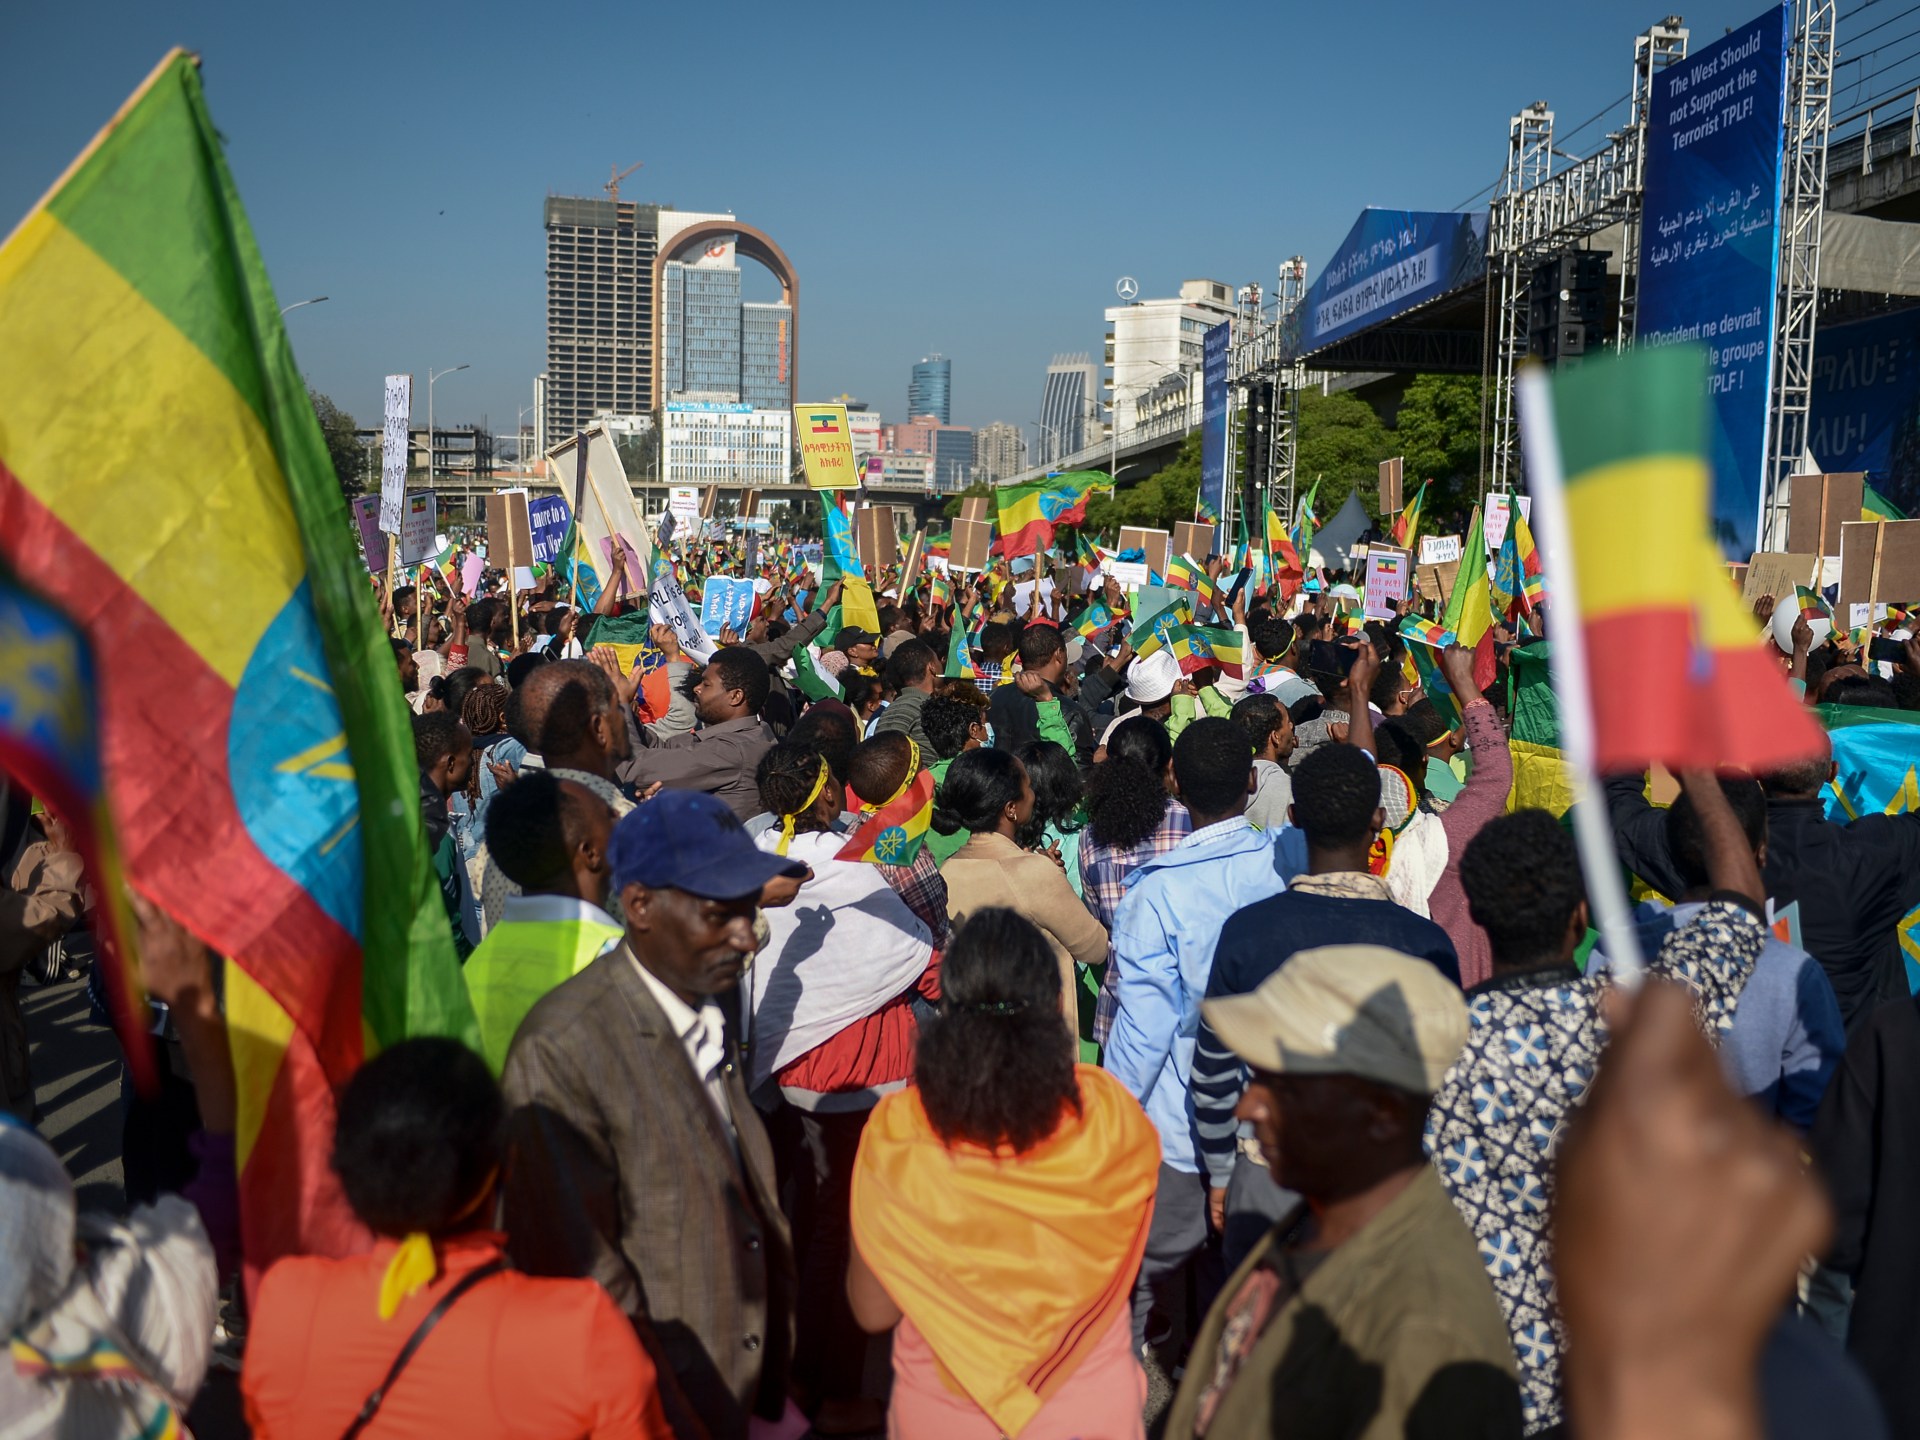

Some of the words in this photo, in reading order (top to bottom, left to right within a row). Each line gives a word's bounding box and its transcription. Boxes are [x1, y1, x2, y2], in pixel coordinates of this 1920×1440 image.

[1669, 78, 1688, 98] The
[1690, 58, 1718, 86] West
[1719, 30, 1761, 71] Should
[1669, 103, 1688, 125] not
[1689, 79, 1735, 120] Support
[1737, 67, 1757, 90] the
[1672, 115, 1719, 151] Terrorist
[1721, 96, 1753, 130] TPLF!
[1716, 189, 1741, 215] الغرب
[1658, 211, 1683, 237] الجبهة
[1684, 208, 1703, 232] يدعم
[1740, 208, 1772, 237] الشعبية
[1711, 219, 1738, 250] لتحرير
[1644, 321, 1701, 350] L'Occident
[1702, 321, 1717, 338] ne
[1719, 306, 1761, 334] devrait
[1709, 346, 1719, 367] le
[1721, 340, 1765, 368] groupe
[1707, 370, 1737, 394] TPLF
[533, 509, 551, 528] more
[551, 504, 560, 523] to
[560, 506, 566, 521] a
